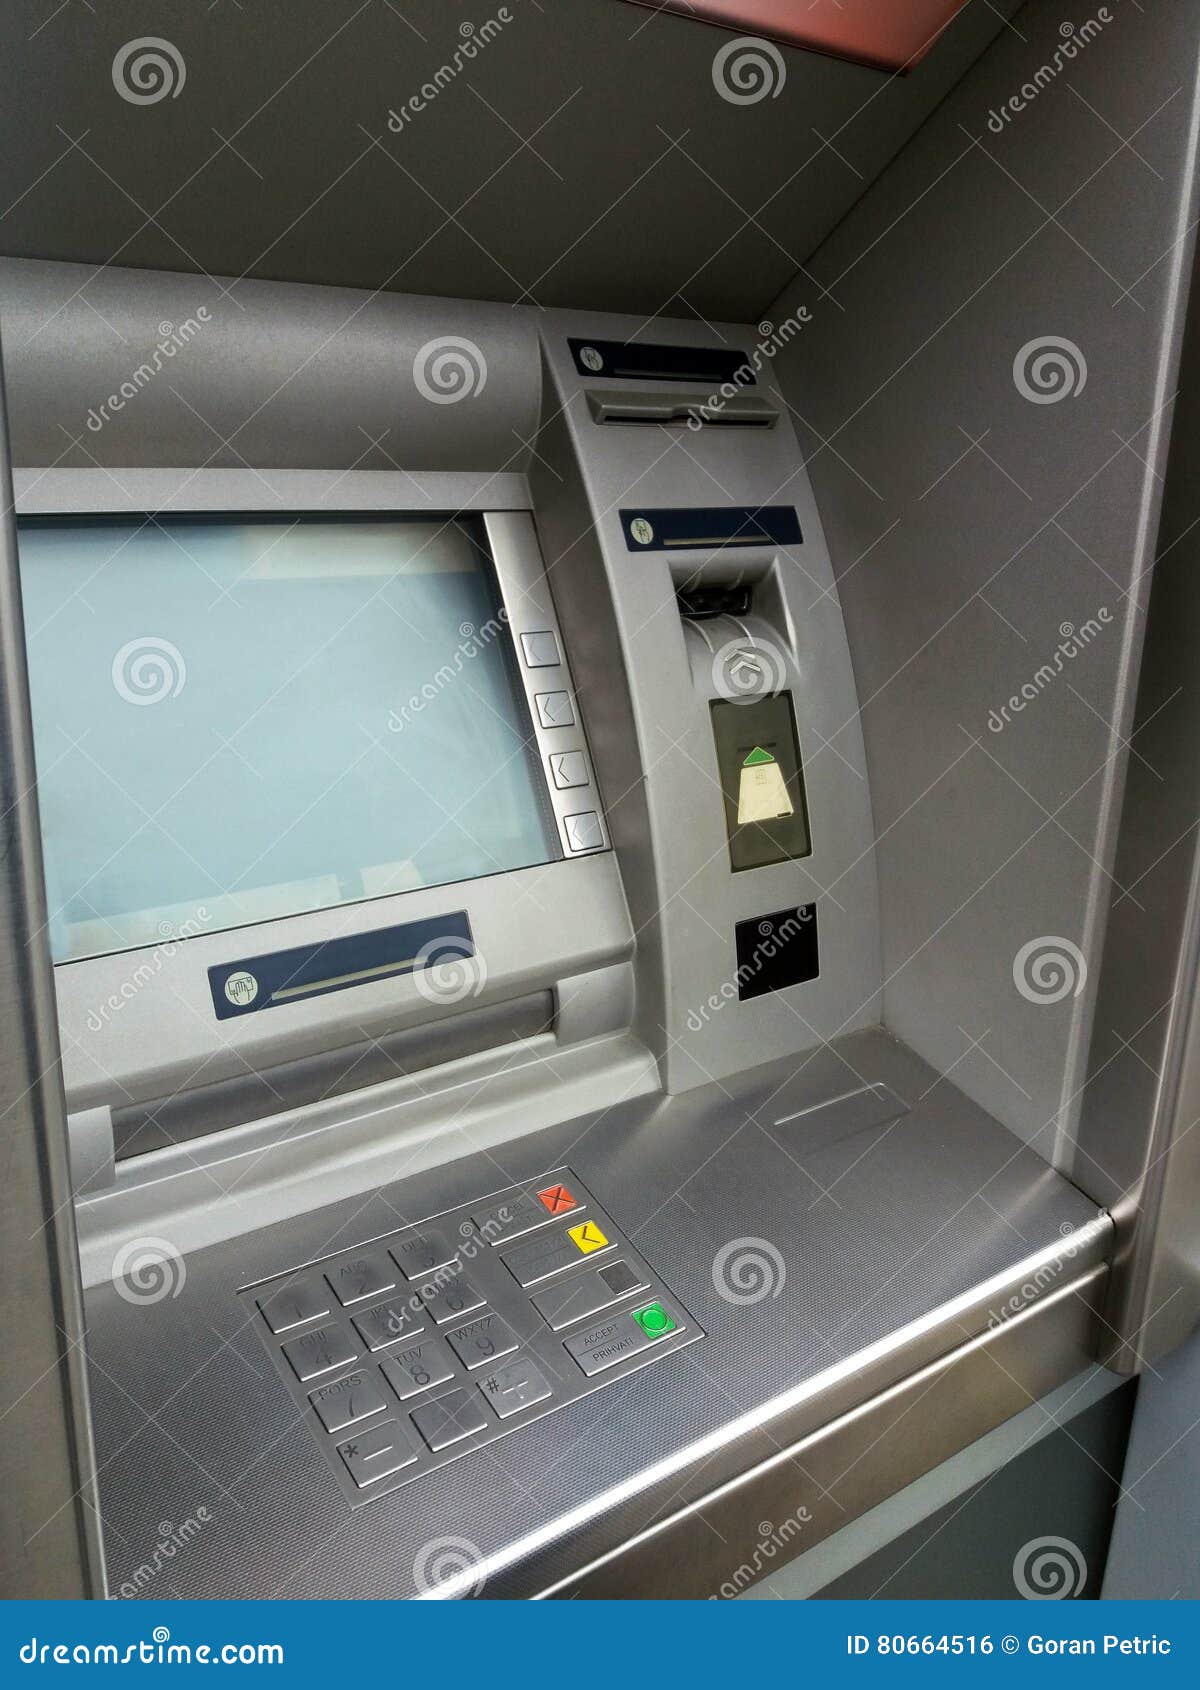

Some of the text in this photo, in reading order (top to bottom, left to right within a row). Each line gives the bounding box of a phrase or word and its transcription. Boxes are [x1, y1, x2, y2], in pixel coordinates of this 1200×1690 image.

[584, 1322, 620, 1347] ACCEPT
[474, 1336, 496, 1358] 9
[409, 1364, 431, 1387] 8
